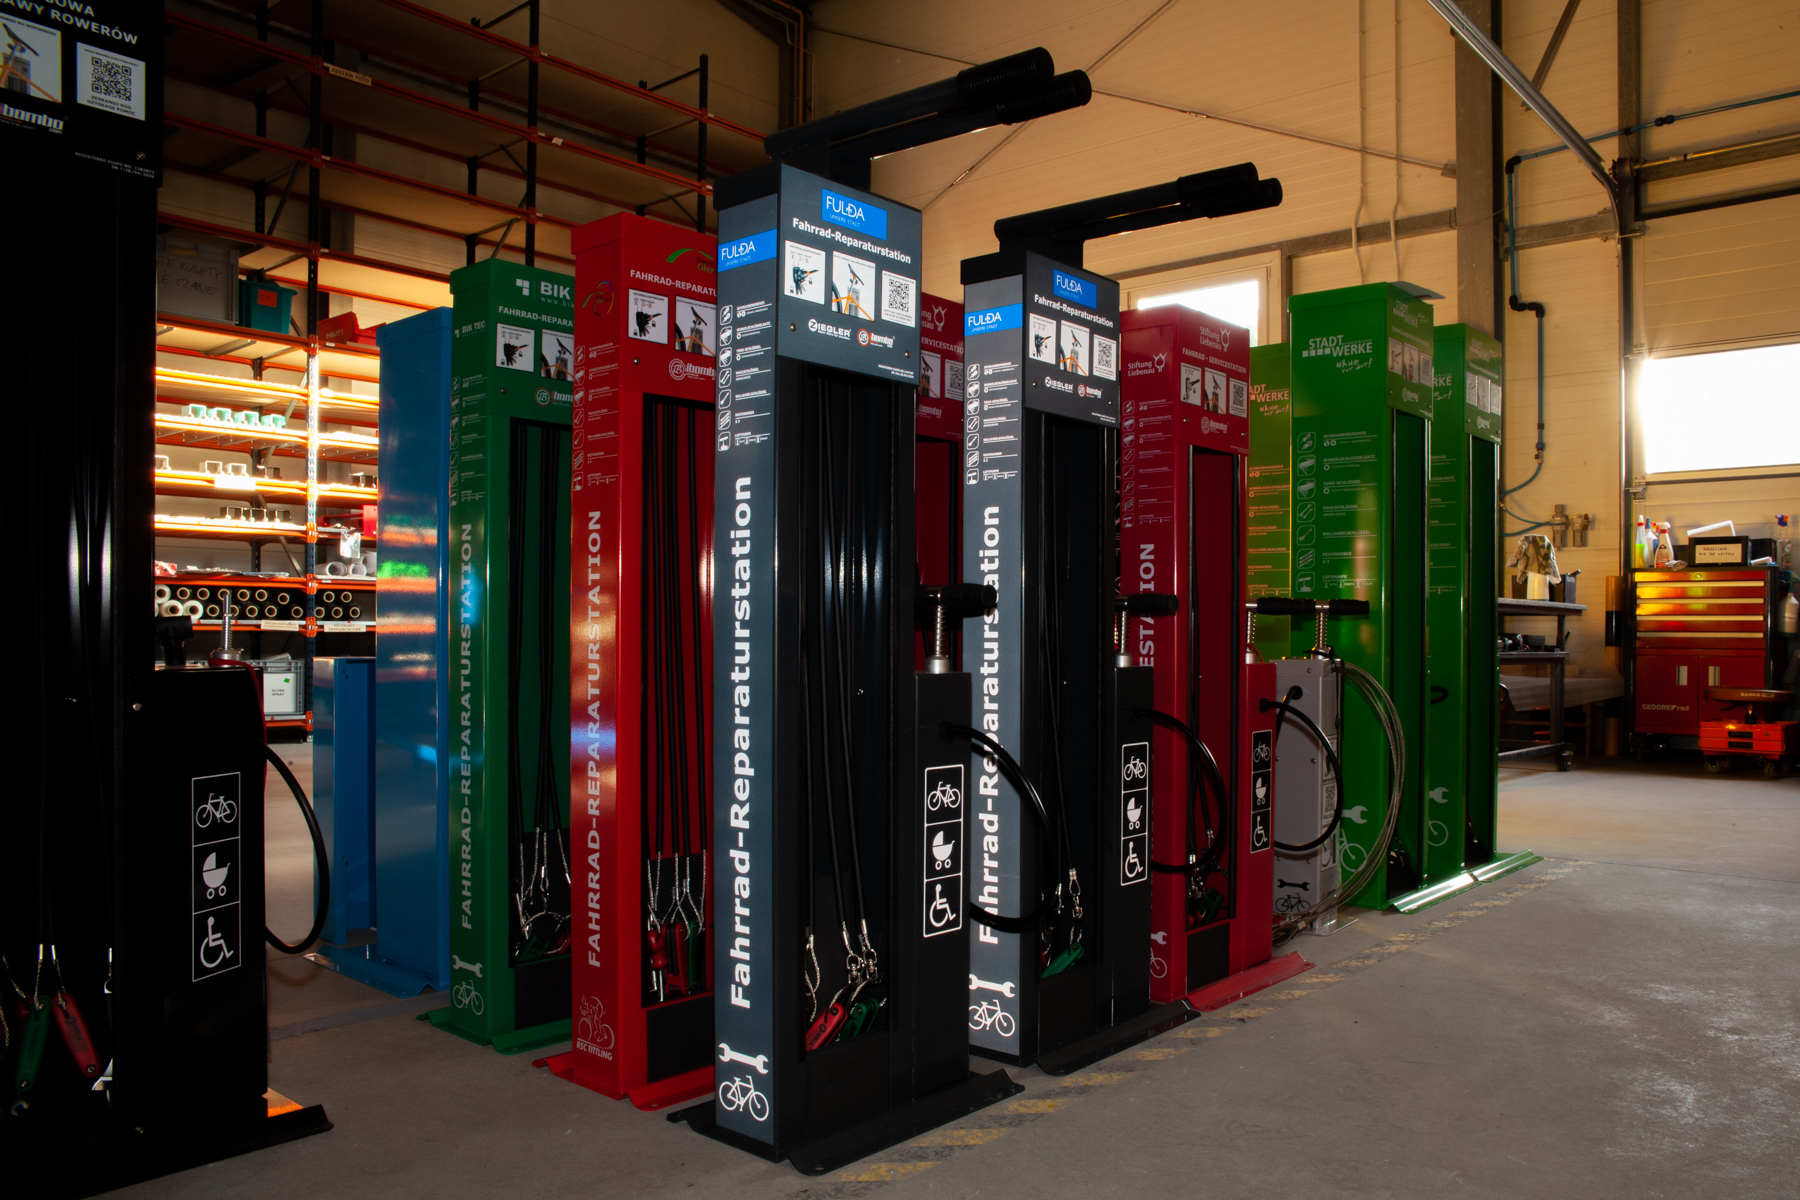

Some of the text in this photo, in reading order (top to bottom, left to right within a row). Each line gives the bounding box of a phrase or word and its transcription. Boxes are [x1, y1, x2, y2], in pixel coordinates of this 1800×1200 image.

[50, 8, 138, 45] ROWERÓW
[826, 195, 865, 221] FULDA
[792, 216, 911, 264] Fahrrad-Reparaturstation
[721, 240, 756, 261] FULDA
[540, 281, 571, 300] BIK
[1056, 274, 1083, 294] FULDA
[968, 311, 1002, 328] FULDA
[1034, 294, 1114, 328] Fahrrad-Reparaturstation
[462, 325, 473, 334] BIK
[473, 320, 486, 330] TEC
[1308, 335, 1344, 350] STADT
[1332, 342, 1373, 358] WERKE
[1182, 347, 1205, 360] FAHRRAD
[1127, 359, 1153, 370] Stiftung
[1128, 367, 1155, 377] Liebenau
[1250, 384, 1266, 394] ADT
[1256, 390, 1289, 402] WERKE
[461, 524, 472, 929] FAHRRAD-REPARATURSTATION
[587, 511, 601, 967] FAHRRAD-REPARATURSTATION
[730, 476, 754, 1009] Fahrrad-Reparaturstation
[576, 1041, 613, 1061] RSC TITTLING
